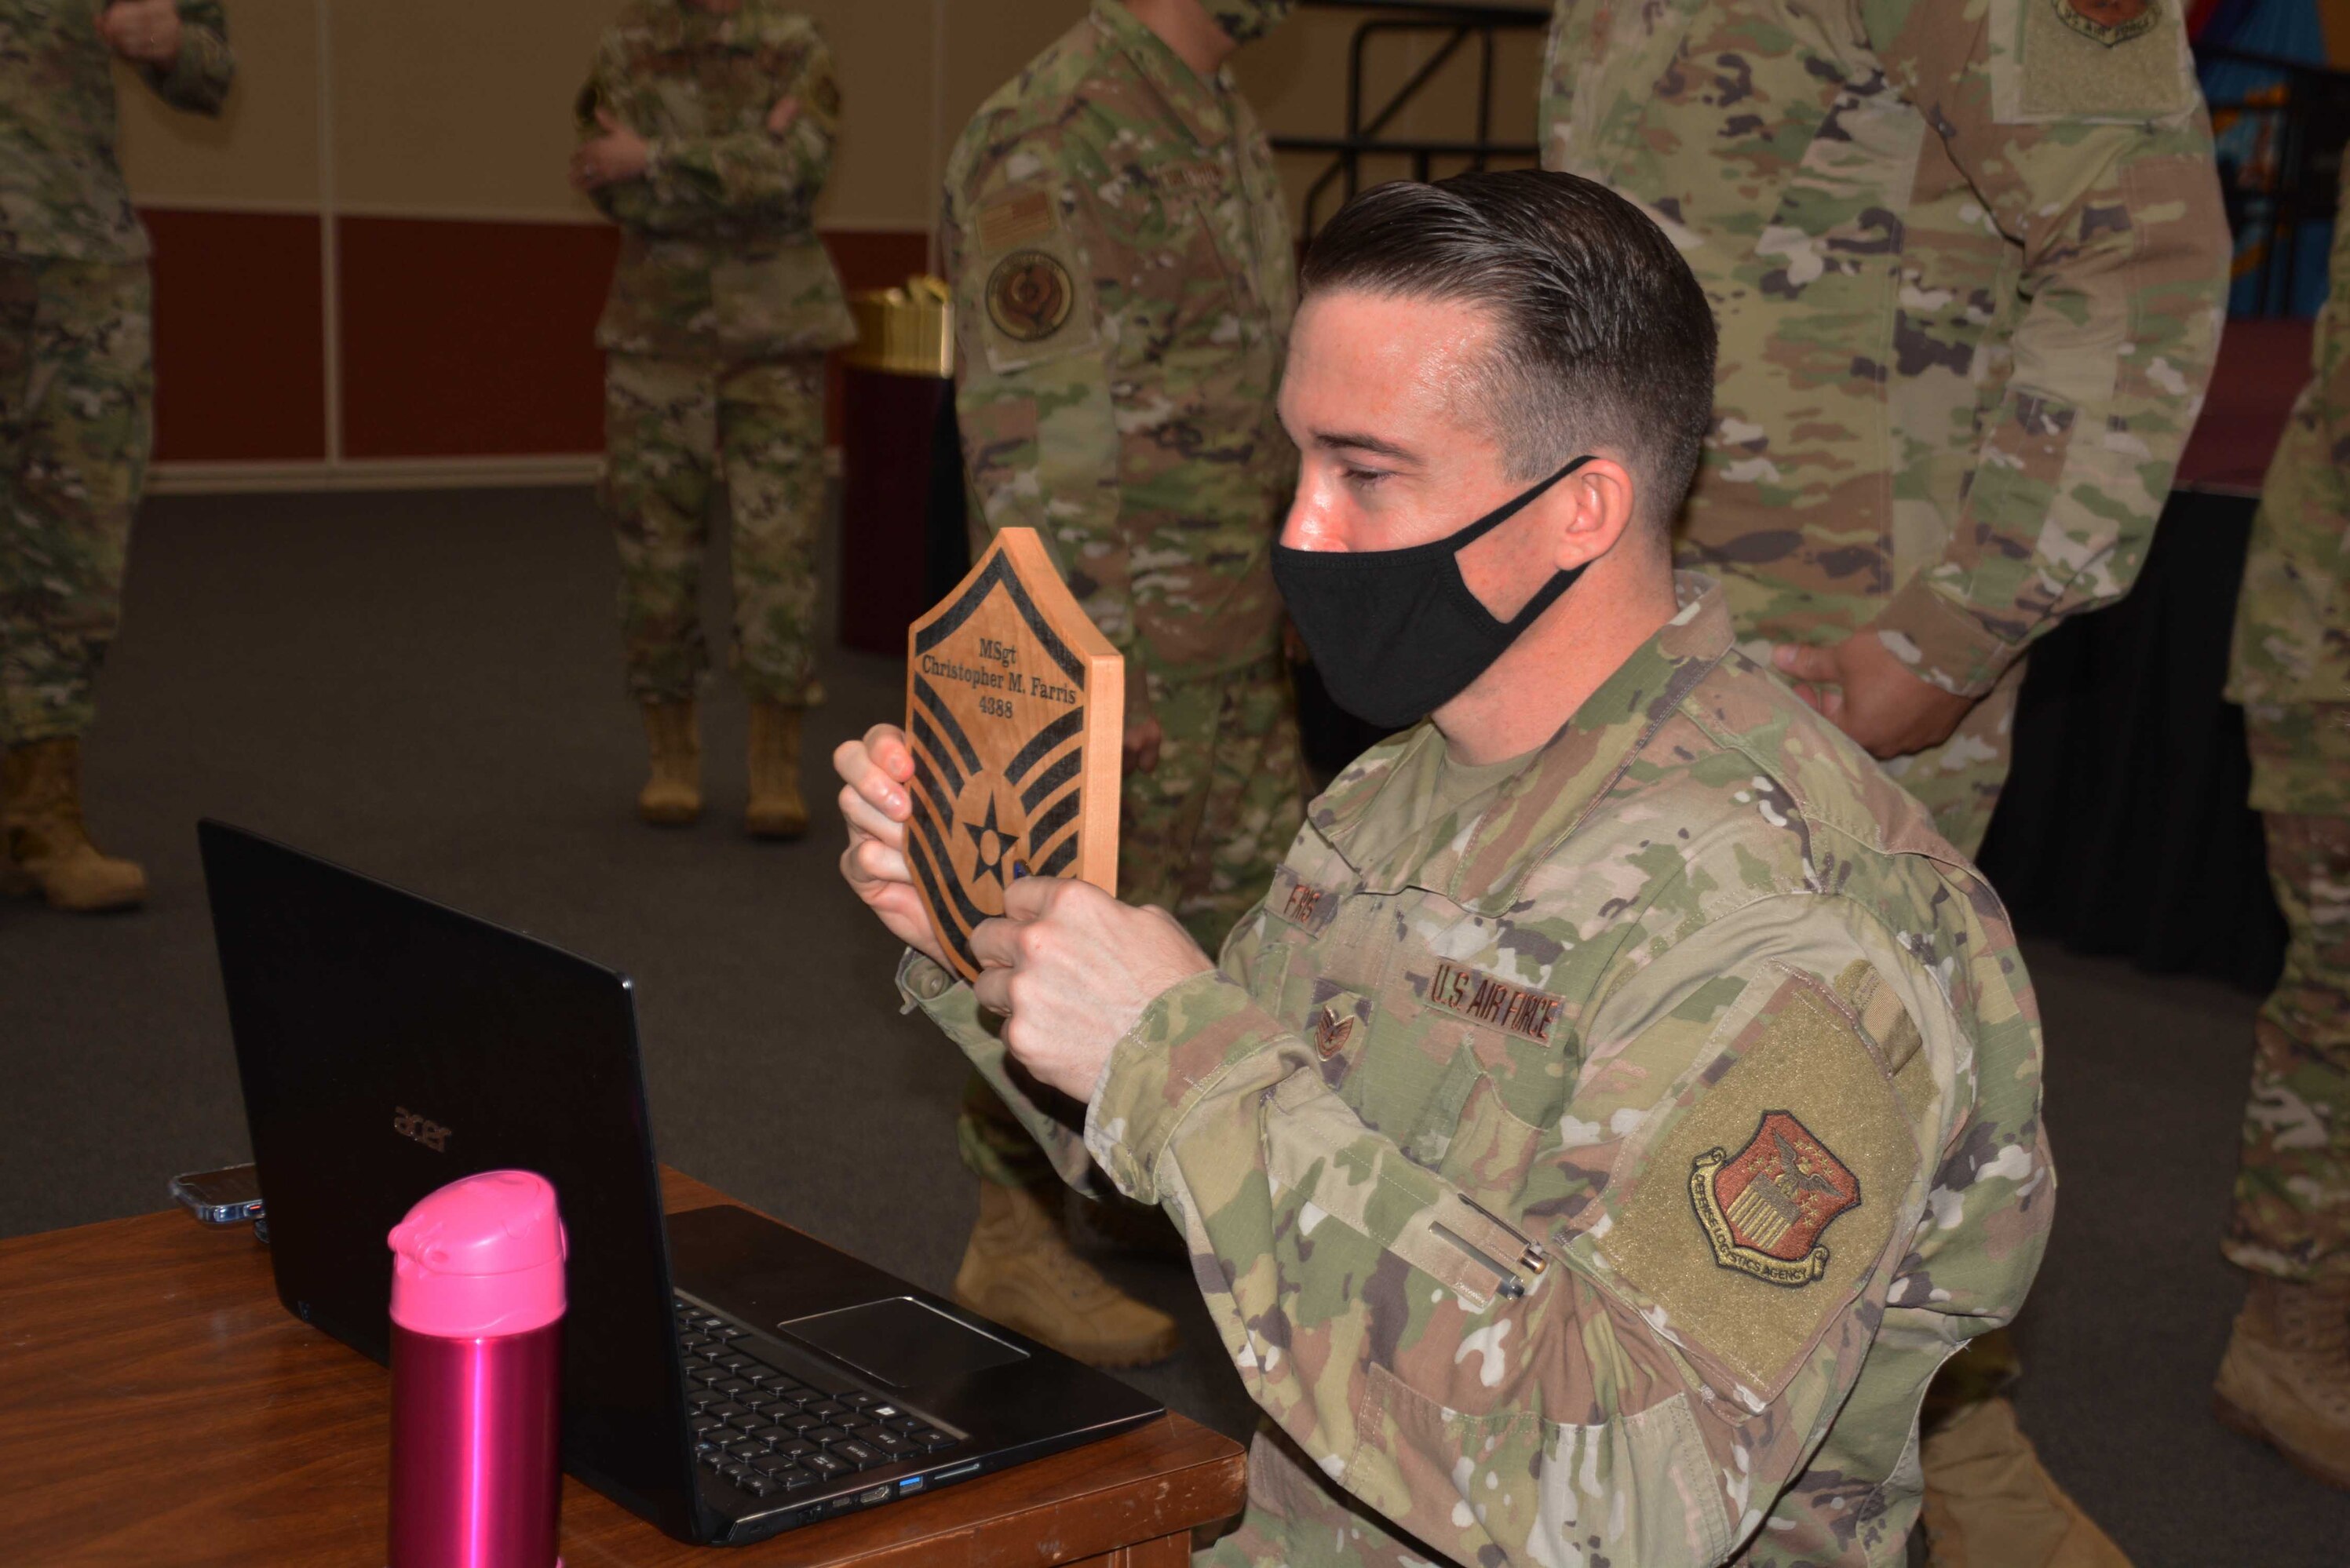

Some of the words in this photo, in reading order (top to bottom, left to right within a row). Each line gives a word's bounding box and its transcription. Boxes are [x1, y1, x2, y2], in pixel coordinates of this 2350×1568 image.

[979, 638, 1017, 667] MSgt
[921, 654, 1004, 689] Christopher
[1008, 671, 1026, 694] M.
[1031, 676, 1076, 705] Farris
[979, 695, 1013, 719] 4388
[1466, 979, 1508, 1023] AIR
[1501, 991, 1560, 1041] FORCE
[394, 1105, 453, 1153] acer
[1695, 1172, 1718, 1227] DEFENSE
[1713, 1227, 1761, 1272] LOGISTICS
[1762, 1265, 1807, 1280] AGENCY
